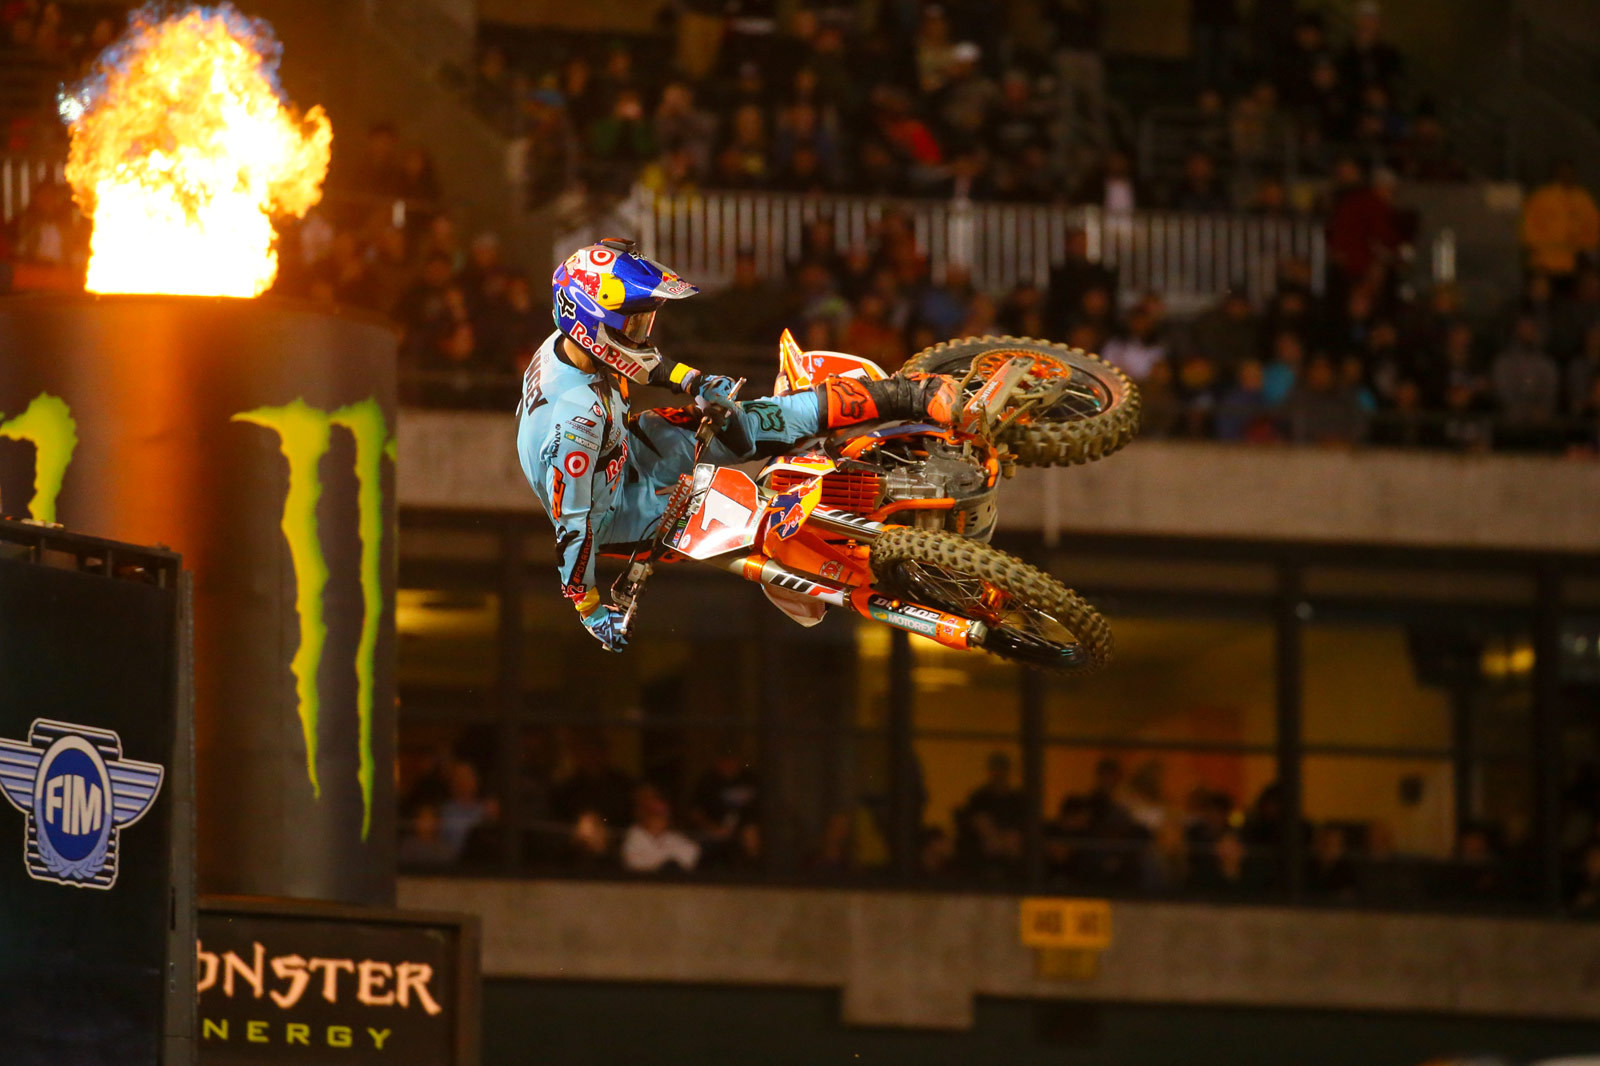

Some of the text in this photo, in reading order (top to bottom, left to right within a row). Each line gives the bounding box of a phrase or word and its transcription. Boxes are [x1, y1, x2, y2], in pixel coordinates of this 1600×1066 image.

[873, 597, 940, 620] DLOP
[887, 613, 935, 635] MOTOREX
[45, 773, 102, 836] FIM
[196, 940, 442, 1016] ONSTER
[202, 1018, 392, 1050] NERGY
